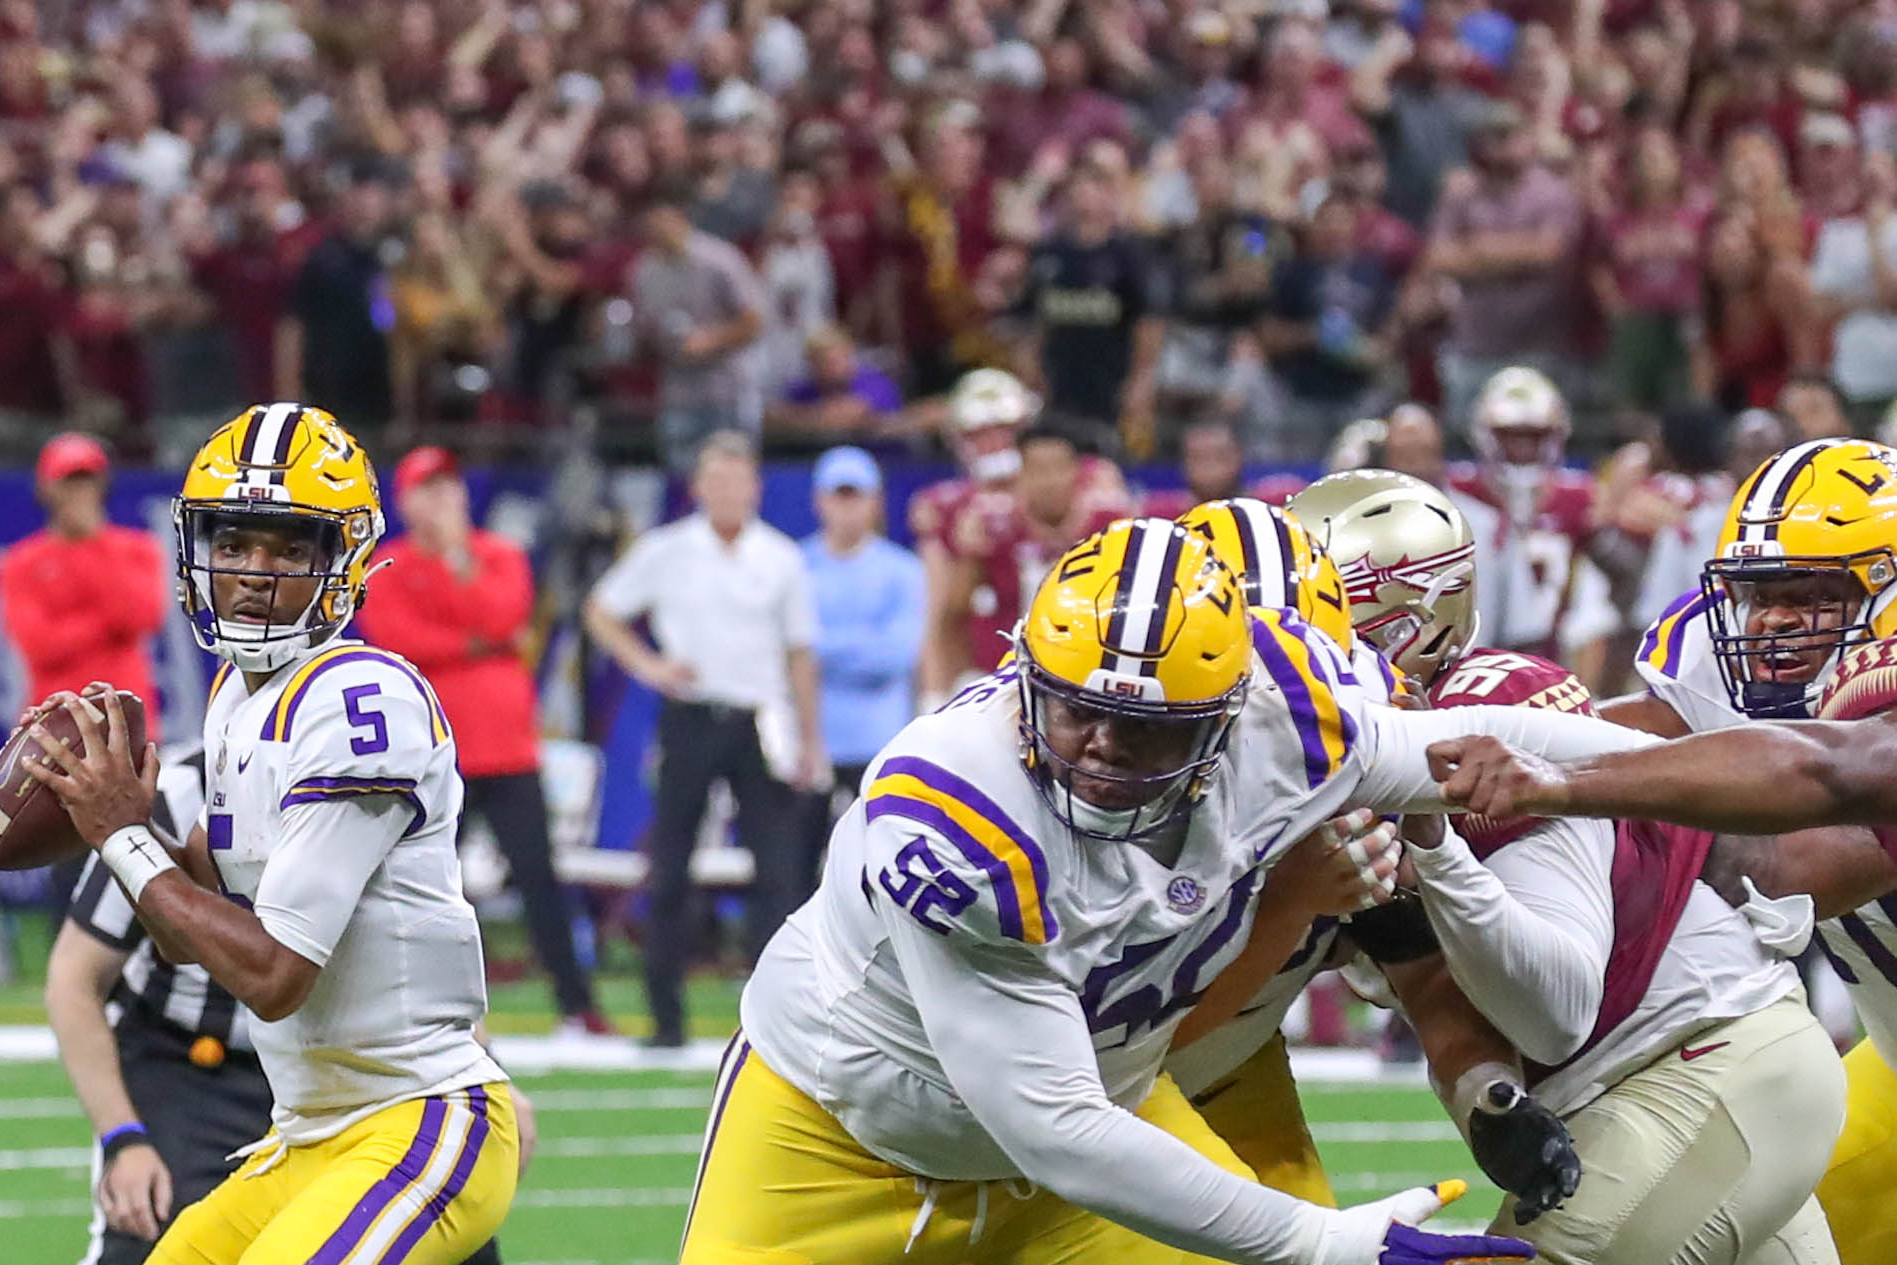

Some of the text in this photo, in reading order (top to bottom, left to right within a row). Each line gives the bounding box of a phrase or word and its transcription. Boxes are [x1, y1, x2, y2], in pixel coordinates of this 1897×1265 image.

[238, 486, 274, 501] LSU
[1732, 543, 1763, 558] LSU
[1103, 679, 1144, 698] LSU
[342, 682, 390, 757] 5
[879, 835, 979, 937] 52
